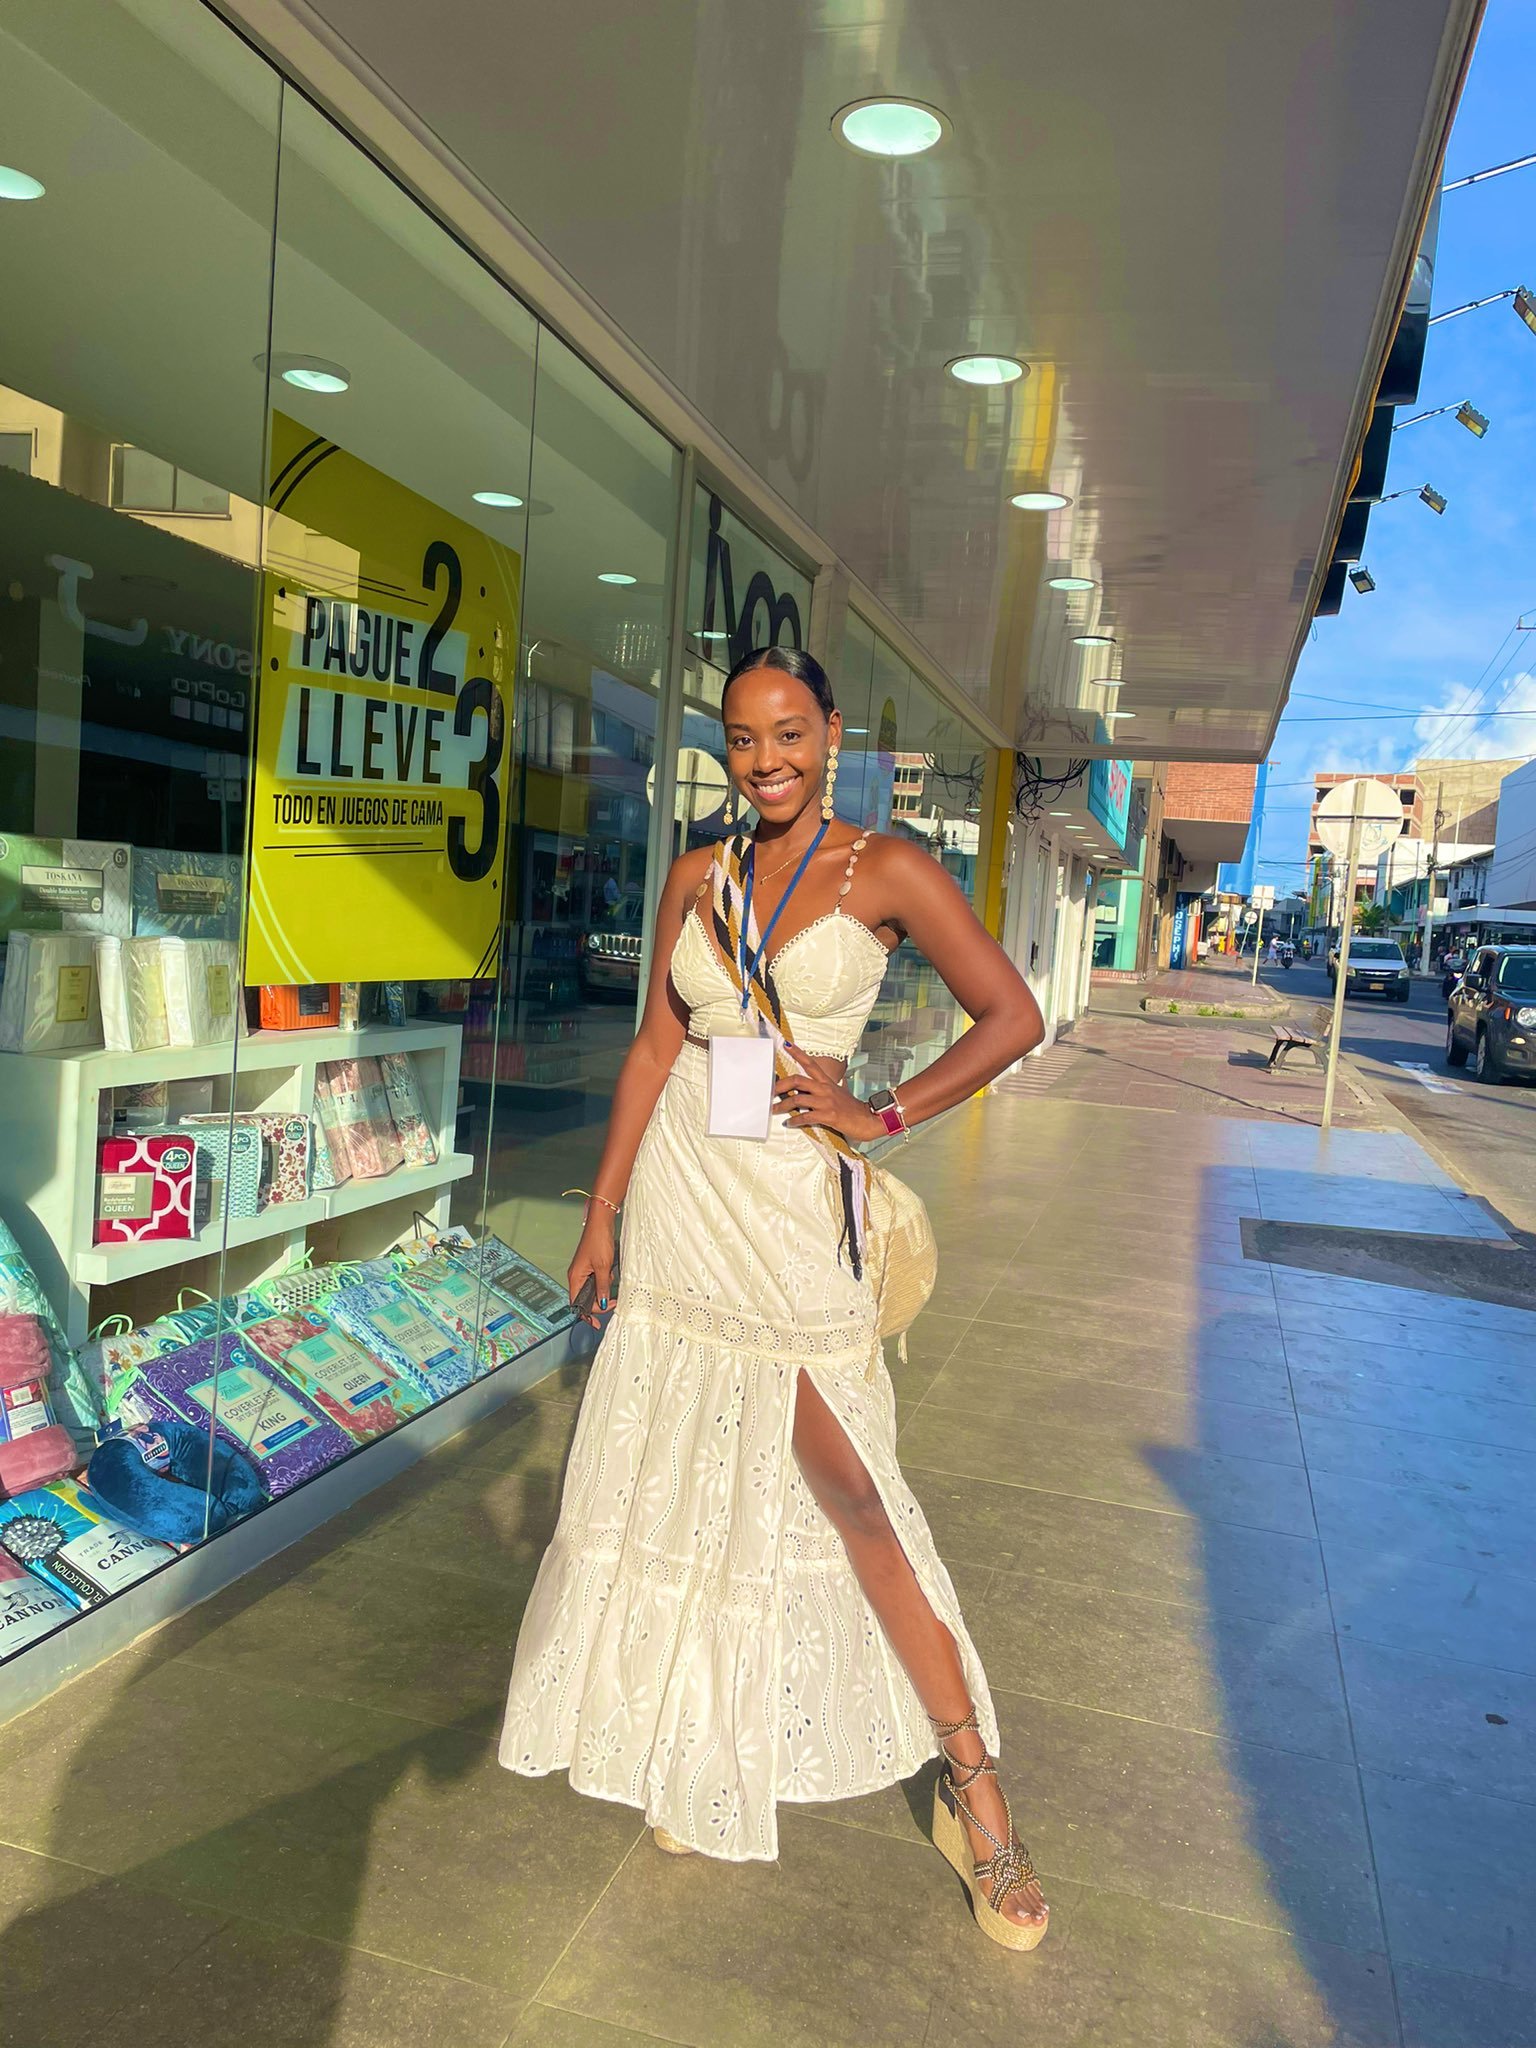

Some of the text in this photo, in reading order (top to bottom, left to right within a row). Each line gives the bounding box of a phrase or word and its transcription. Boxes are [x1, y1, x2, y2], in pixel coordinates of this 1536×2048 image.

[302, 541, 462, 696] PAGUE 2
[297, 677, 504, 882] LLEVE 3
[273, 794, 443, 826] TODO EN JUEGOS DE CAMA
[45, 871, 83, 881] TOSKANA
[165, 1150, 187, 1161] 4PCS
[104, 1205, 135, 1213] QUEEN
[233, 1351, 247, 1363] 3
[419, 1340, 440, 1354] FULL
[314, 1352, 360, 1379] COVERLET SET
[342, 1372, 372, 1391] QUEEN
[223, 1394, 265, 1419] COVERLET
[257, 1411, 287, 1431] KING
[96, 1538, 157, 1570] CANNO
[52, 1561, 95, 1596] COLLECTION
